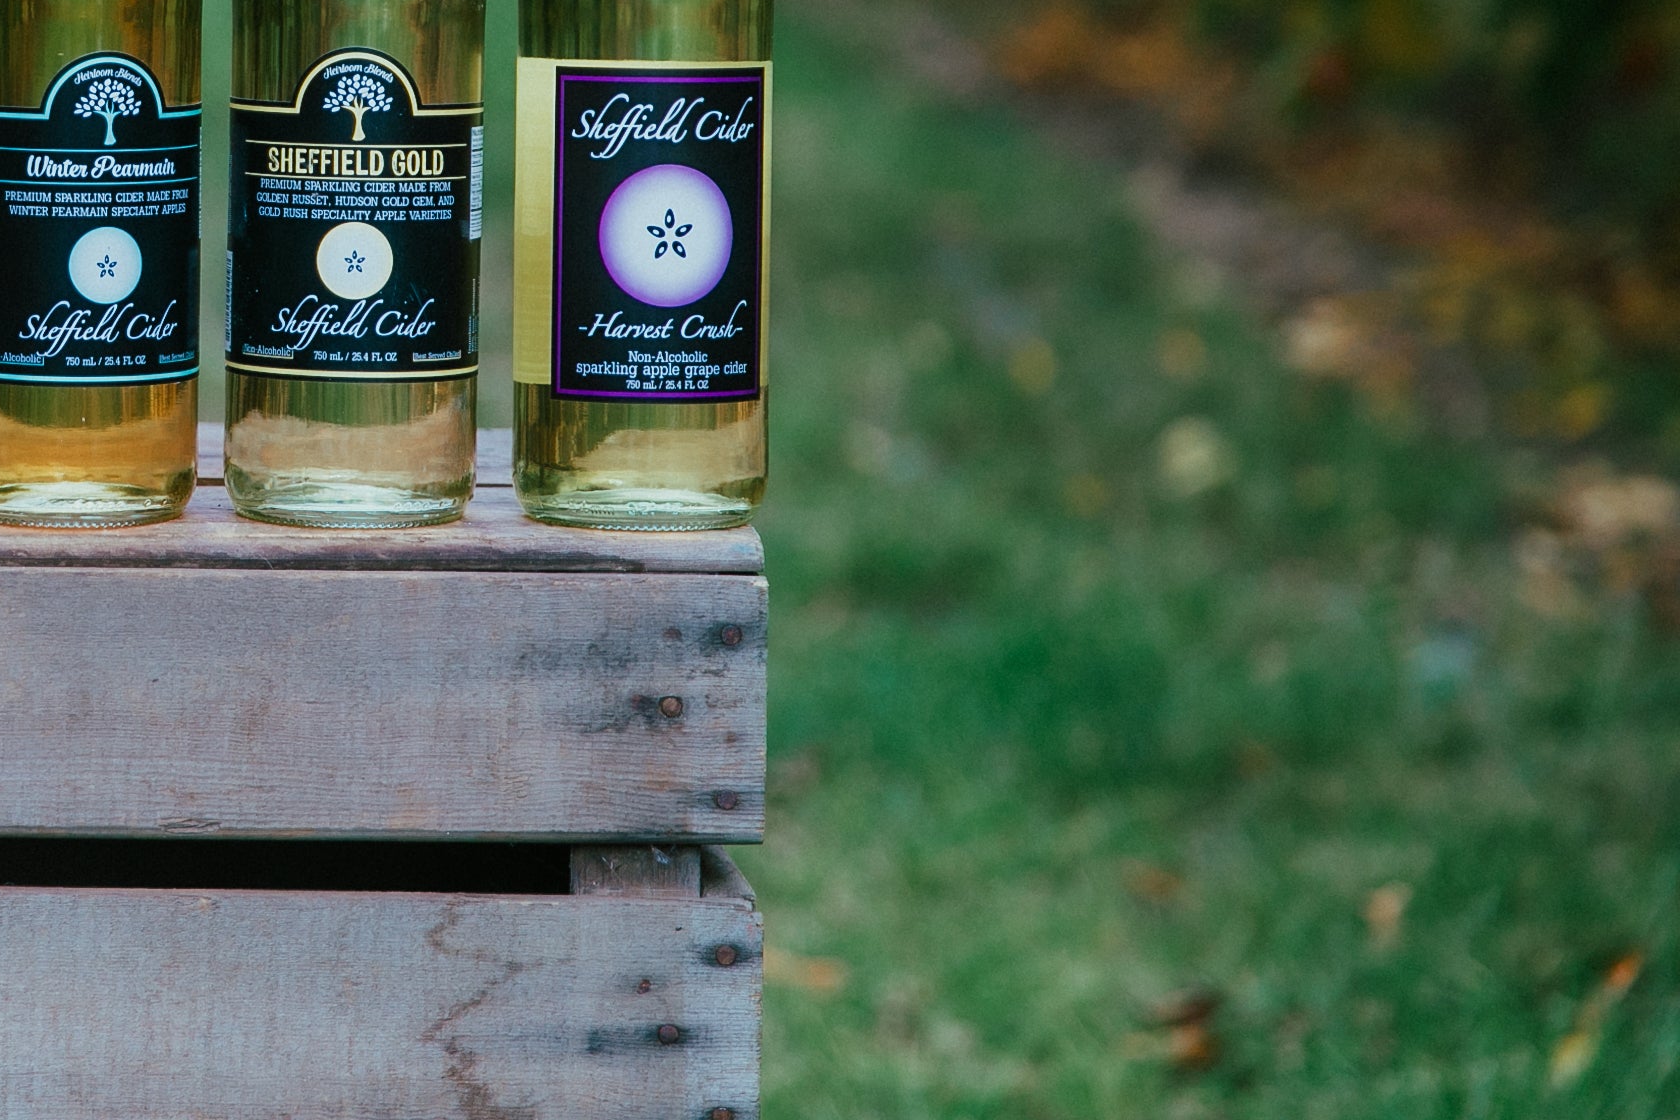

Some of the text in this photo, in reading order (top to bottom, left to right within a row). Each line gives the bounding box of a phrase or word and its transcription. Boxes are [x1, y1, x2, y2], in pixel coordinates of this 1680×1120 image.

[74, 68, 142, 87] Heirloom Blends
[323, 64, 394, 83] Heirloom Blends
[571, 93, 754, 159] Sheffield Cider
[27, 155, 175, 179] Winter Pearmain
[269, 147, 444, 176] SHEFFIELD GOLD
[260, 178, 451, 192] PREMIUM SPARKLING CIDER MADE FROM
[5, 189, 189, 203] PREMIUM SPARKLING CIDER MADE FROM
[257, 192, 454, 207] GOLDEN RUSSET, HUDSON GOLD GEM, AND
[9, 203, 186, 216] WINTER PEARMAIN SPECIALTY APPLES
[259, 207, 452, 220] GOLD RUSH SPECIALITY APPLE VARIETIES
[19, 300, 134, 357] Sheffield
[126, 299, 178, 340] Cider
[271, 294, 384, 351] Sheffield
[376, 298, 436, 338] Cider
[66, 356, 80, 366] 750
[83, 356, 96, 366] mL
[105, 356, 120, 366] 25.4
[123, 356, 133, 366] FL
[135, 356, 146, 365] OZ
[314, 351, 328, 360] 750
[330, 351, 343, 360] mL
[351, 352, 368, 361] 25.4
[371, 352, 382, 361] FL
[385, 352, 397, 361] OZ
[628, 351, 708, 363] Non-Alcoholic
[576, 361, 748, 377] sparkling apple grape cider
[626, 380, 640, 389] 750
[642, 380, 657, 389] mL
[666, 380, 682, 389] 25.4
[684, 380, 695, 389] FL
[697, 380, 709, 389] OZ
